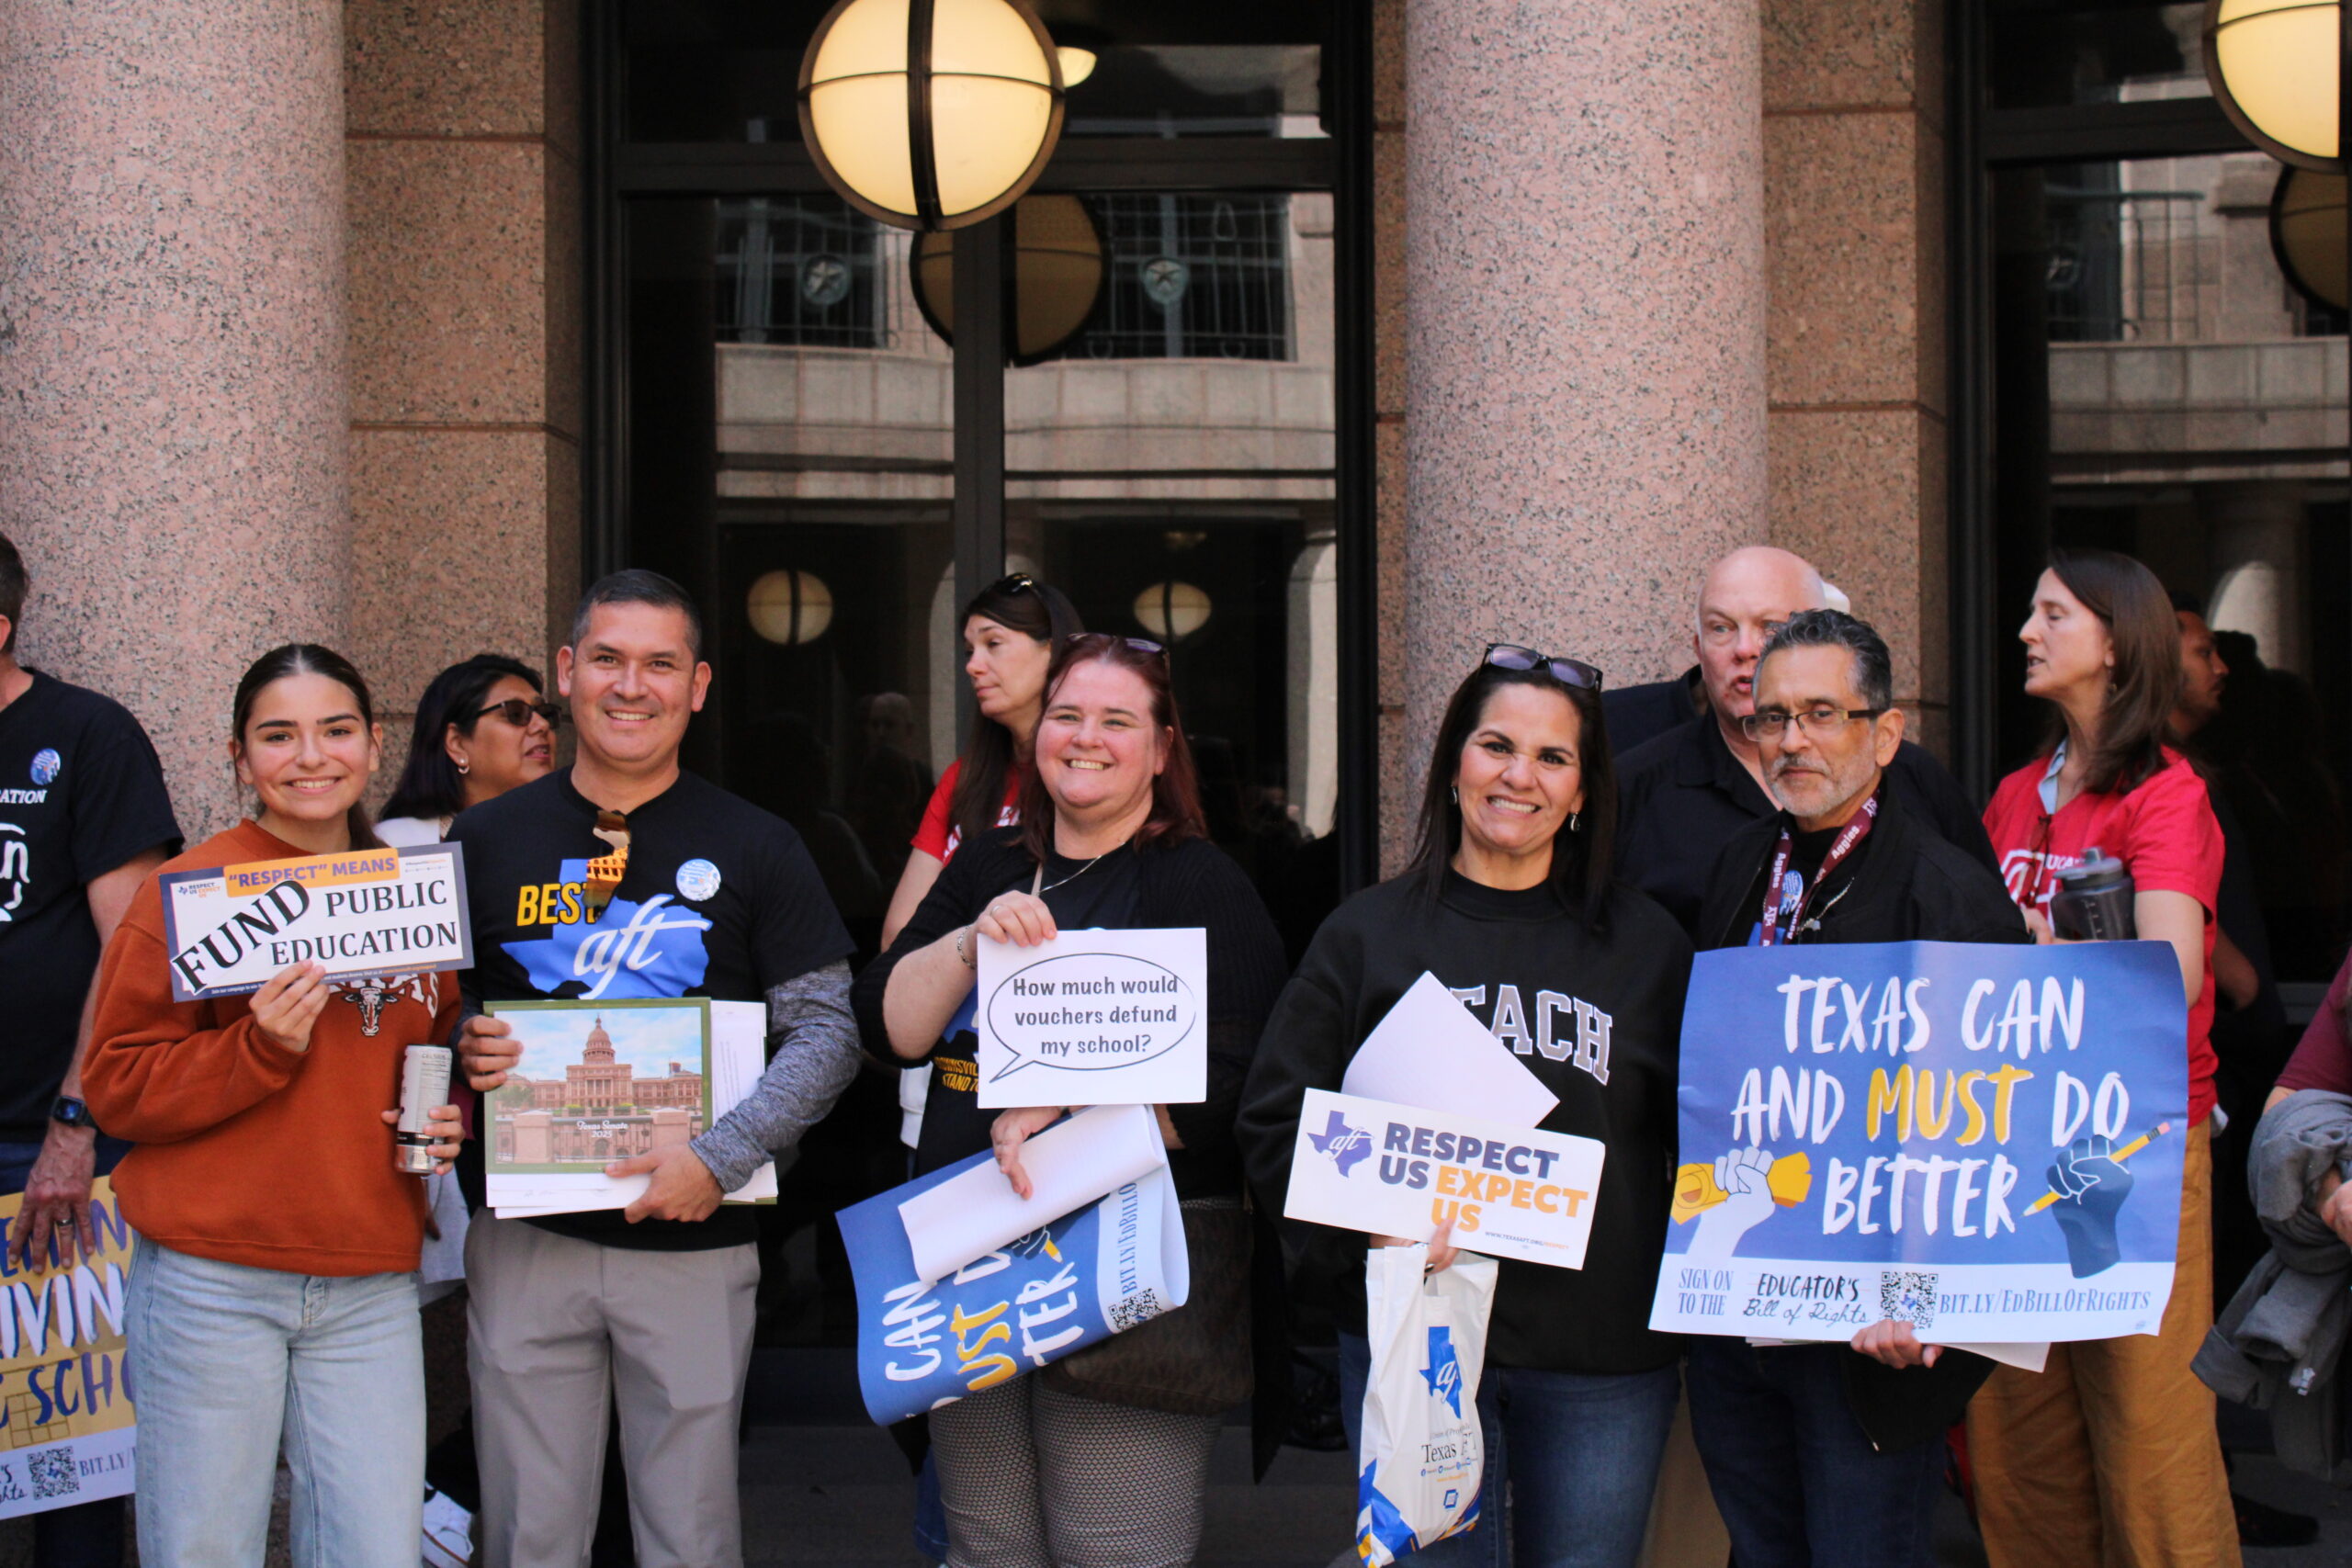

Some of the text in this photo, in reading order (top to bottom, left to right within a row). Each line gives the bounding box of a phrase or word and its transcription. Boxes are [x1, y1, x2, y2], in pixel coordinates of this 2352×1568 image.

[0, 789, 47, 805] ATION
[1831, 825, 1860, 860] Aggies
[333, 857, 396, 876] MEANS
[1772, 852, 1786, 889] Aggies
[172, 880, 447, 993] FUND PUBLIC
[271, 921, 458, 965] EDUCATION
[573, 895, 712, 999] aft
[1013, 976, 1178, 996] How much would
[1014, 1005, 1177, 1026] vouchers defund
[1777, 975, 2085, 1059] TEXAS CAN
[1041, 1034, 1151, 1057] my school?
[1730, 1064, 2130, 1147] AND MUST DO
[1329, 1126, 1374, 1161] aft
[1384, 1122, 1560, 1179] RESPECT
[1379, 1154, 1589, 1218] US EXPECT
[1823, 1154, 2018, 1238] BETTER
[1430, 1197, 1483, 1233] US
[1679, 1269, 1734, 1292] SIGN ON
[1757, 1273, 1860, 1302] EDUCATOR'S
[1678, 1292, 1727, 1315] TO THE
[1743, 1298, 1871, 1327] Bill of Rights
[882, 1280, 946, 1382] CAN
[1421, 1443, 1457, 1463] Texas
